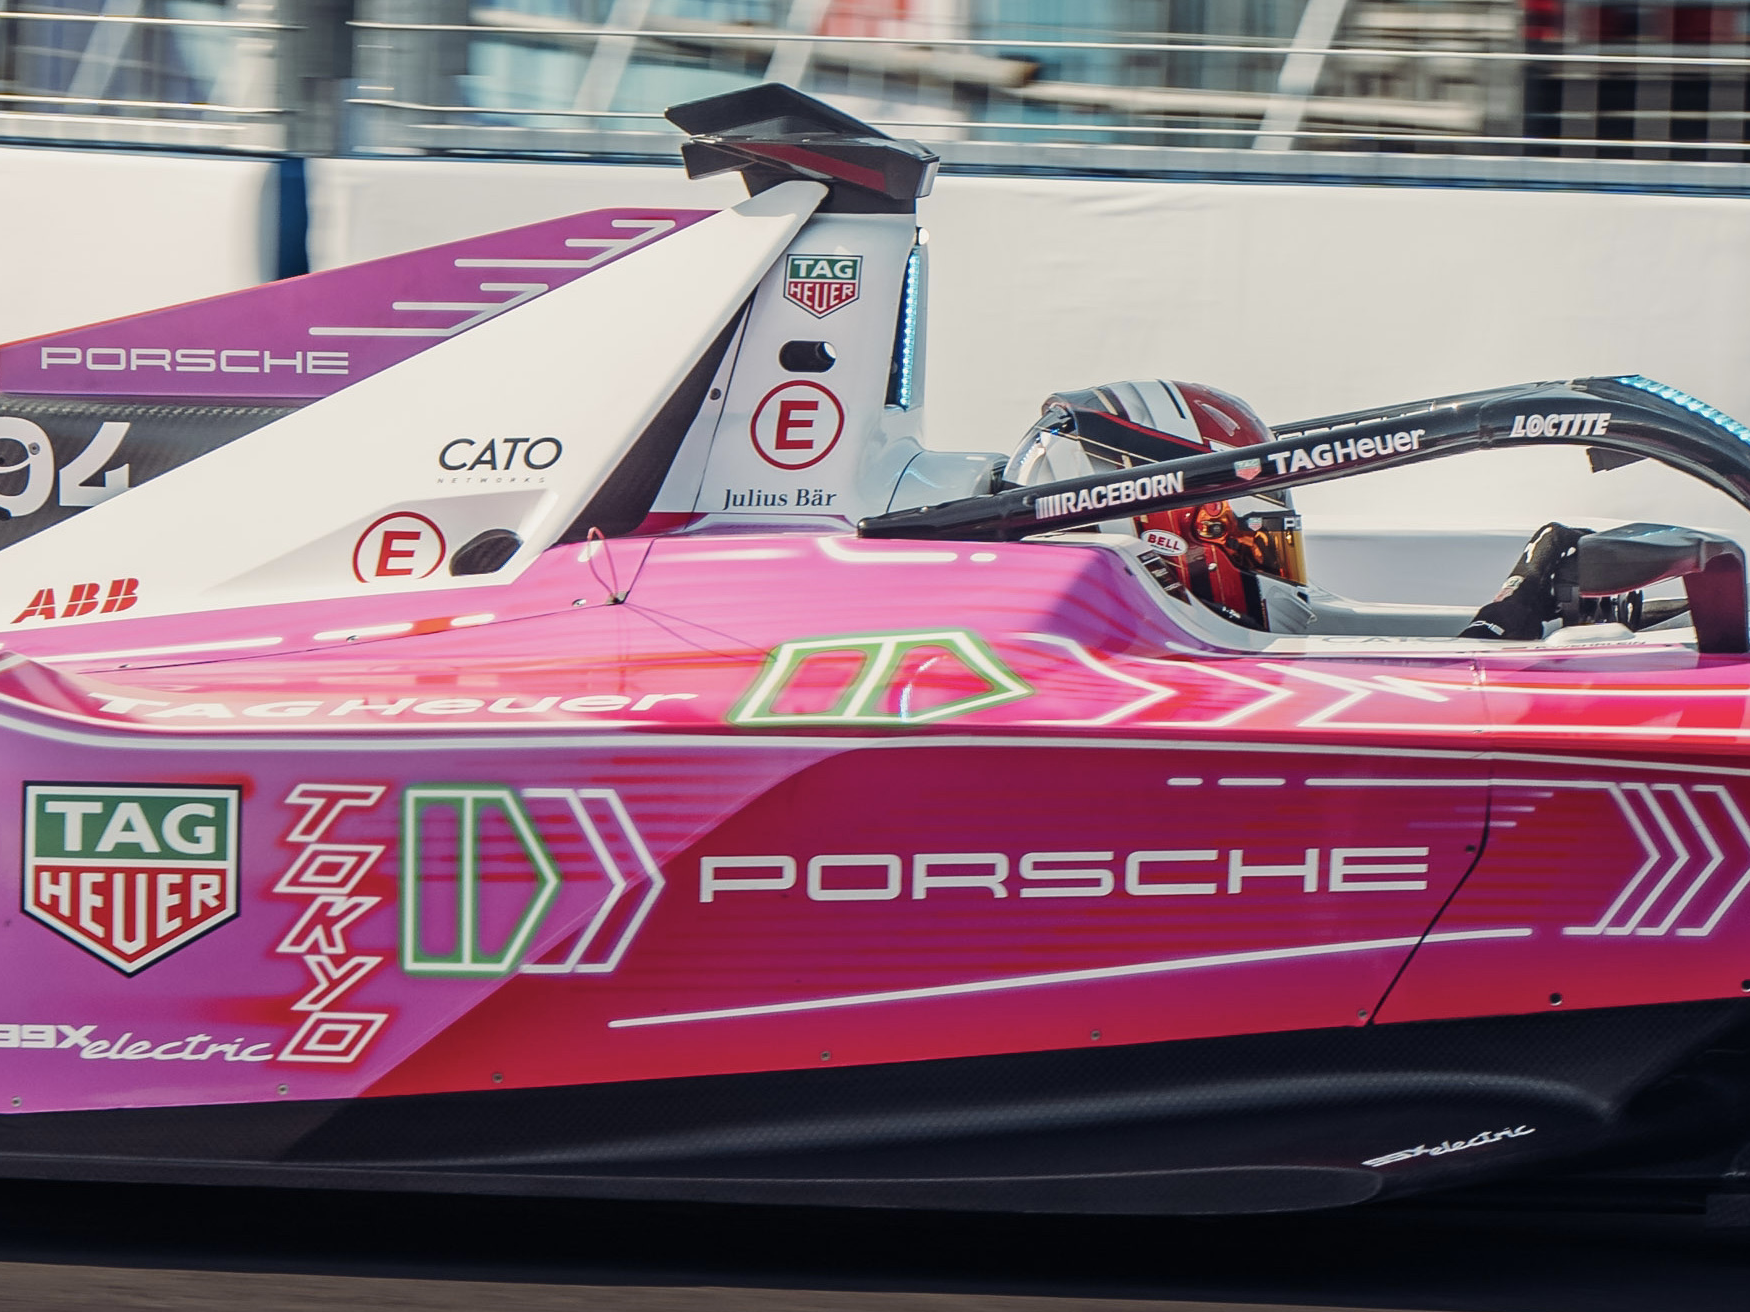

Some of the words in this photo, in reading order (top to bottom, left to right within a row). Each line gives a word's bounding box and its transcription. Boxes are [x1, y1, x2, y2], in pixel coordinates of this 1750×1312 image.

[793, 259, 854, 279] TAG
[789, 281, 854, 312] HEUER
[40, 346, 350, 375] PORSCHE
[1509, 412, 1612, 438] LOCTITE
[438, 437, 563, 471] CATO
[722, 488, 788, 511] Julius
[794, 488, 838, 507] Bär
[1147, 534, 1180, 552] BELL
[9, 577, 140, 625] ABB
[44, 800, 217, 856] TAG
[699, 846, 1430, 904] PORSCHE
[39, 871, 222, 956] HEUER
[272, 782, 389, 1064] TOKYO
